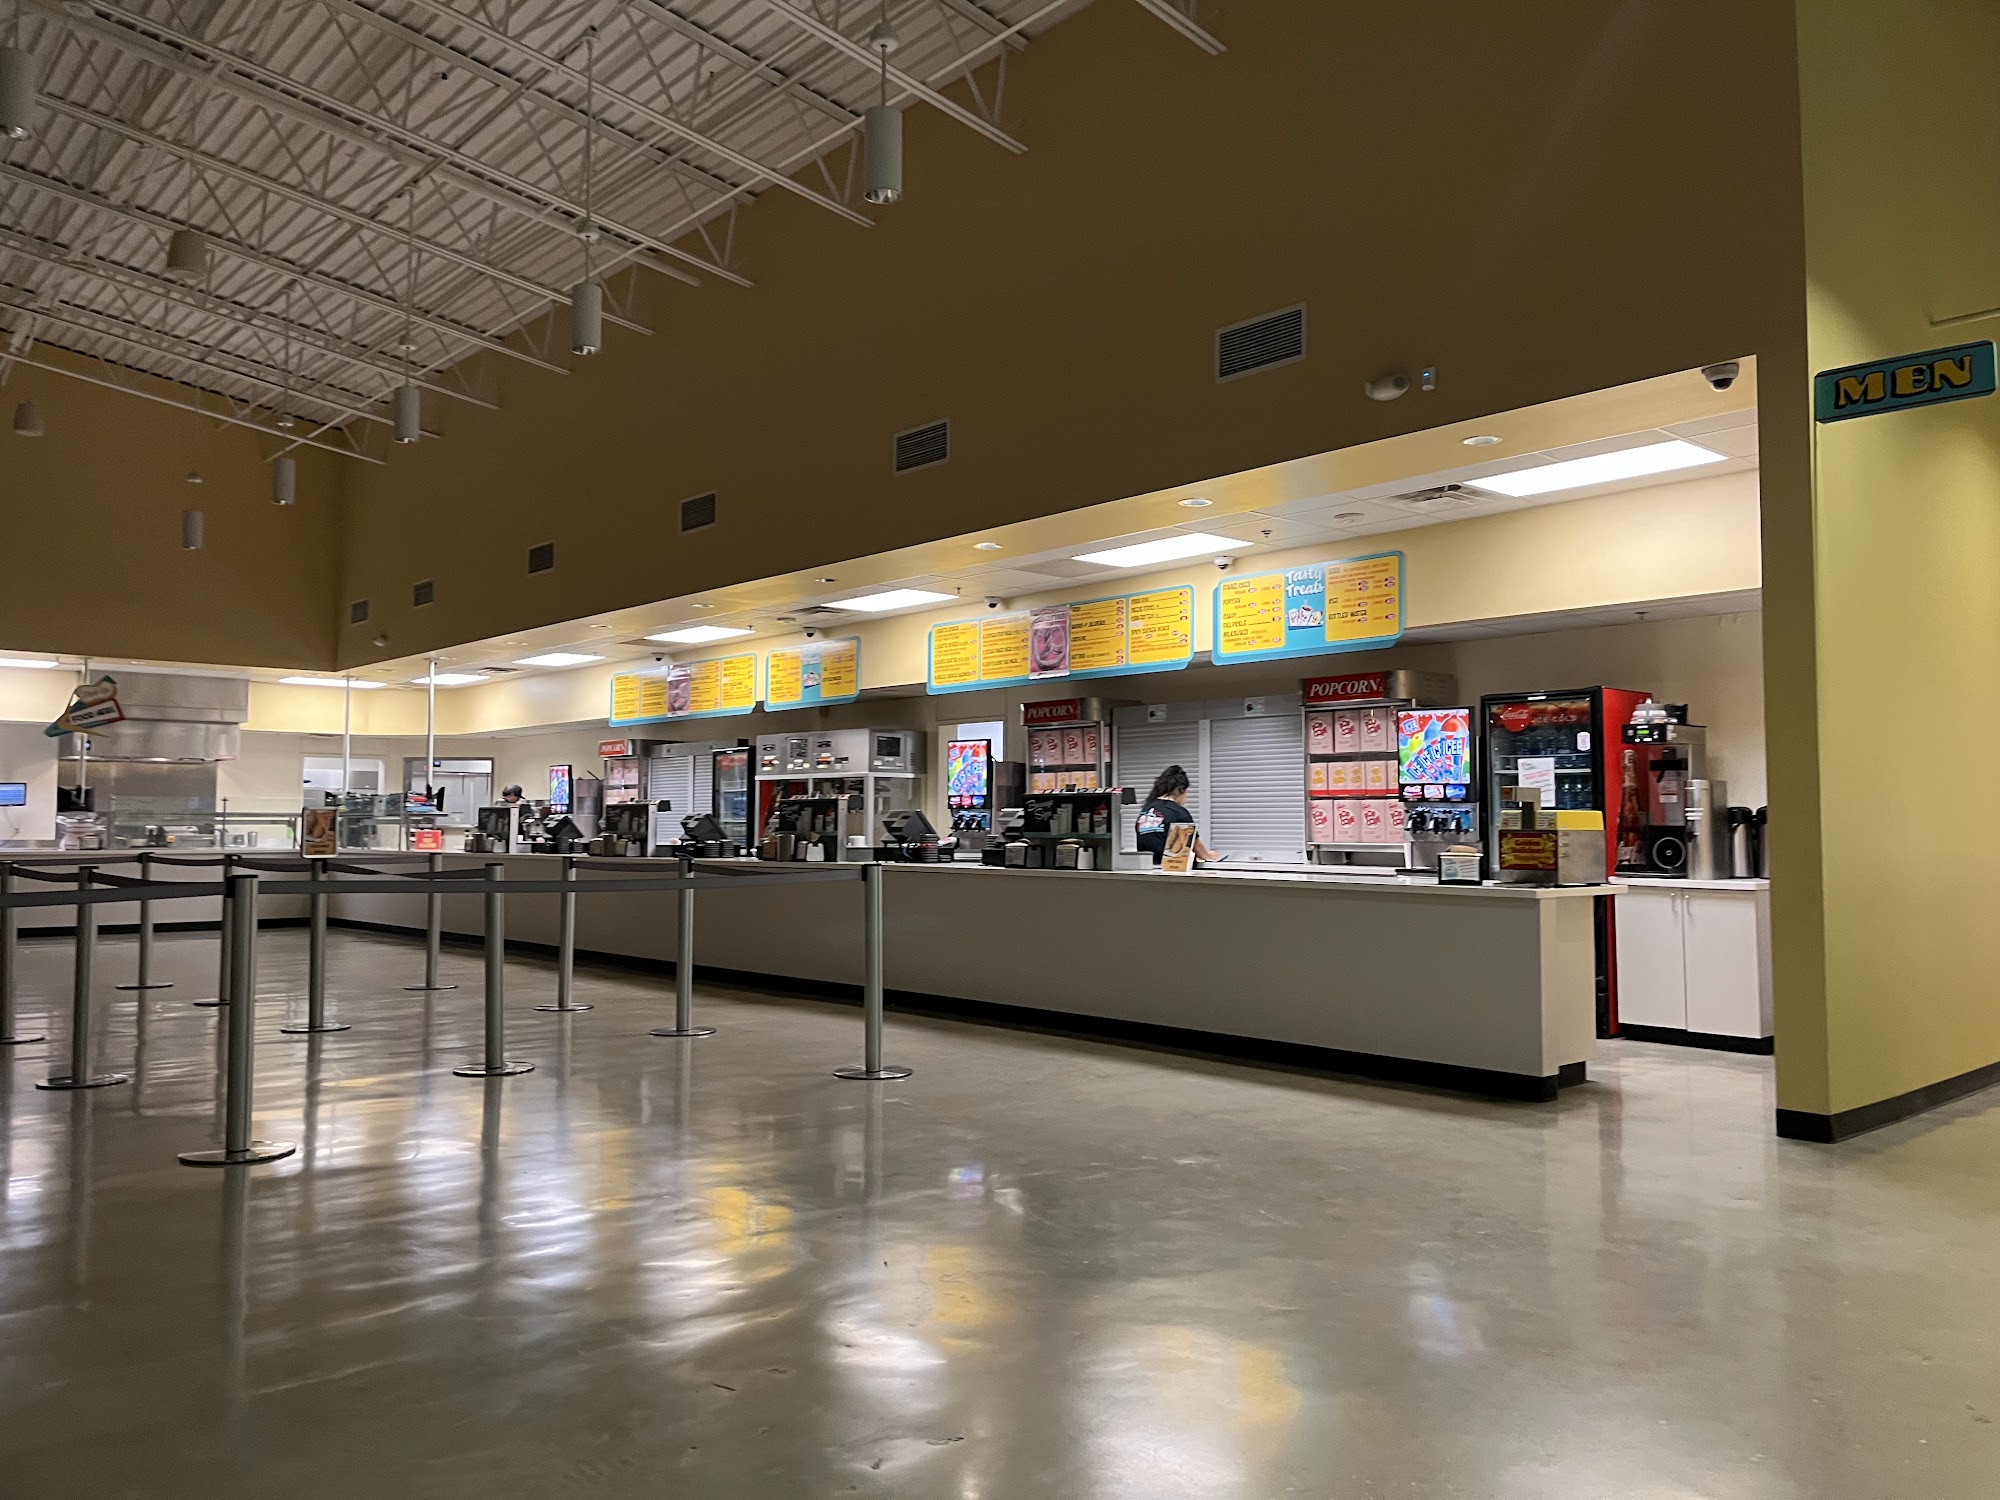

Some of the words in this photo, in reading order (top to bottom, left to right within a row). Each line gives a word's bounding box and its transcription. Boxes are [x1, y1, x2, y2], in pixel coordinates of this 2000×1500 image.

[1834, 354, 1972, 409] MEN
[1285, 569, 1322, 585] Tasty
[1285, 580, 1325, 598] Treats
[1309, 678, 1381, 698] POPCORN
[1026, 703, 1077, 719] POPCORN
[1443, 740, 1463, 755] ICEE
